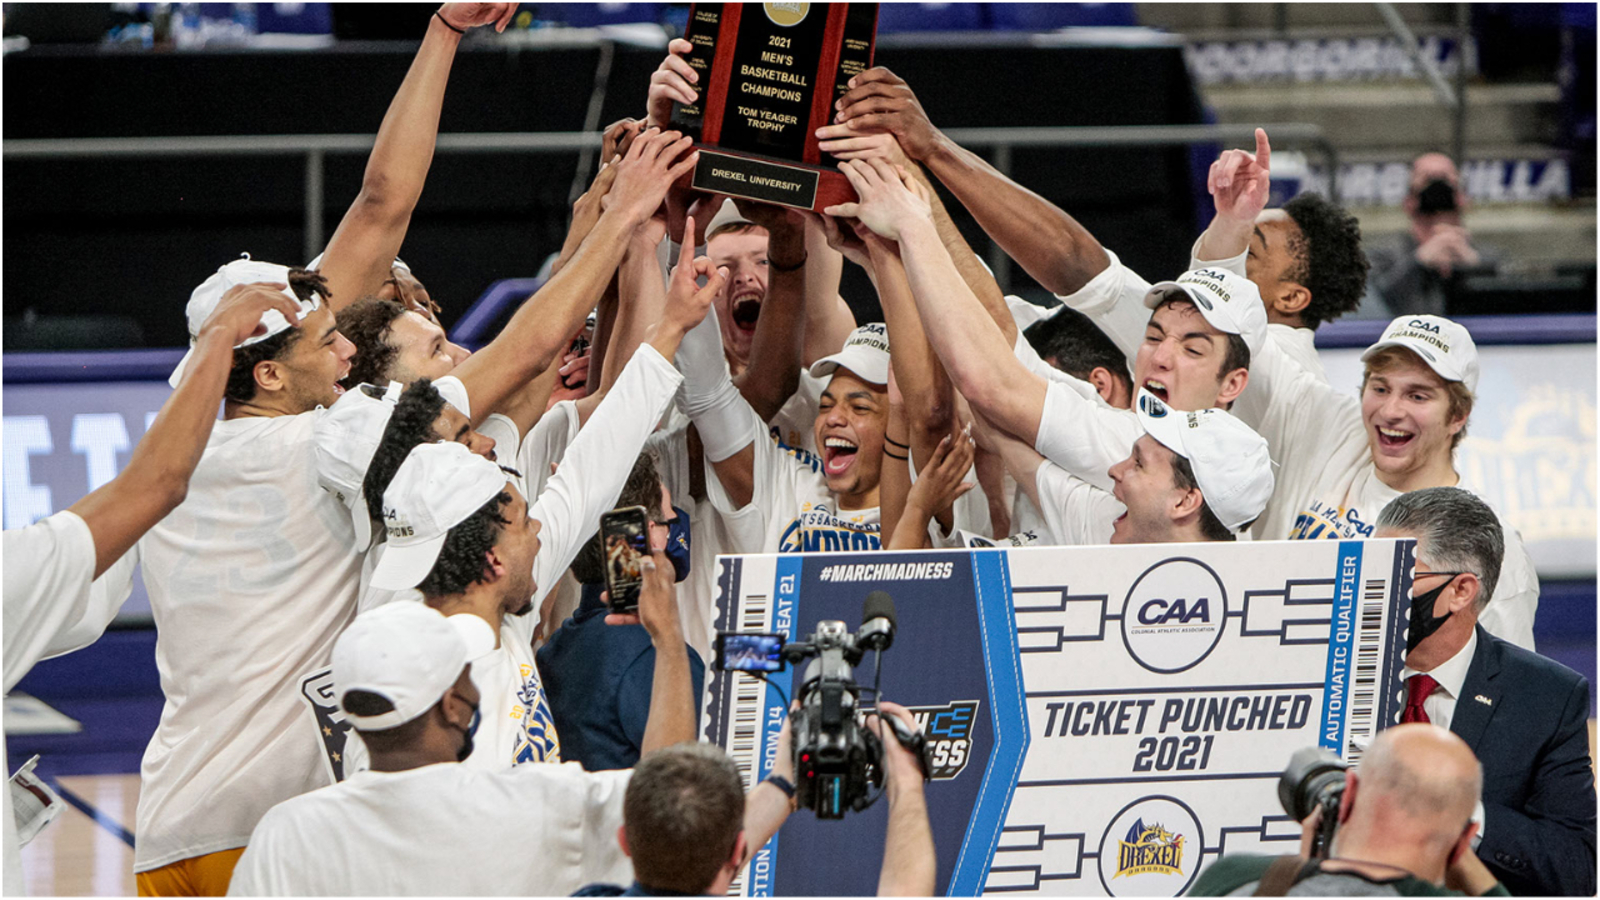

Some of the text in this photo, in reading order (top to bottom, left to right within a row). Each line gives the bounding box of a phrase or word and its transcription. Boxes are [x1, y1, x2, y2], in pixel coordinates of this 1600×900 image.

[768, 35, 792, 49] 2021
[761, 51, 794, 66] MEN'S
[741, 64, 808, 87] BASKETBALL
[741, 82, 802, 102] CHAMPIONS
[737, 105, 798, 125] TOM YEAGER
[747, 118, 785, 133] TROPHY
[711, 168, 802, 192] DREXEL UNIVERSITY
[1408, 319, 1440, 334] CAA
[819, 561, 954, 582] #MARCHMADNESS
[779, 573, 796, 595] 21
[1335, 555, 1358, 639] QUALIFIER
[1137, 597, 1211, 625] CAA
[1325, 646, 1348, 742] AUTOMATIC
[768, 705, 784, 727] 14
[1044, 694, 1313, 738] TICKET PUNCHED
[1132, 735, 1215, 772] 2021
[1119, 842, 1184, 873] DREXEL
